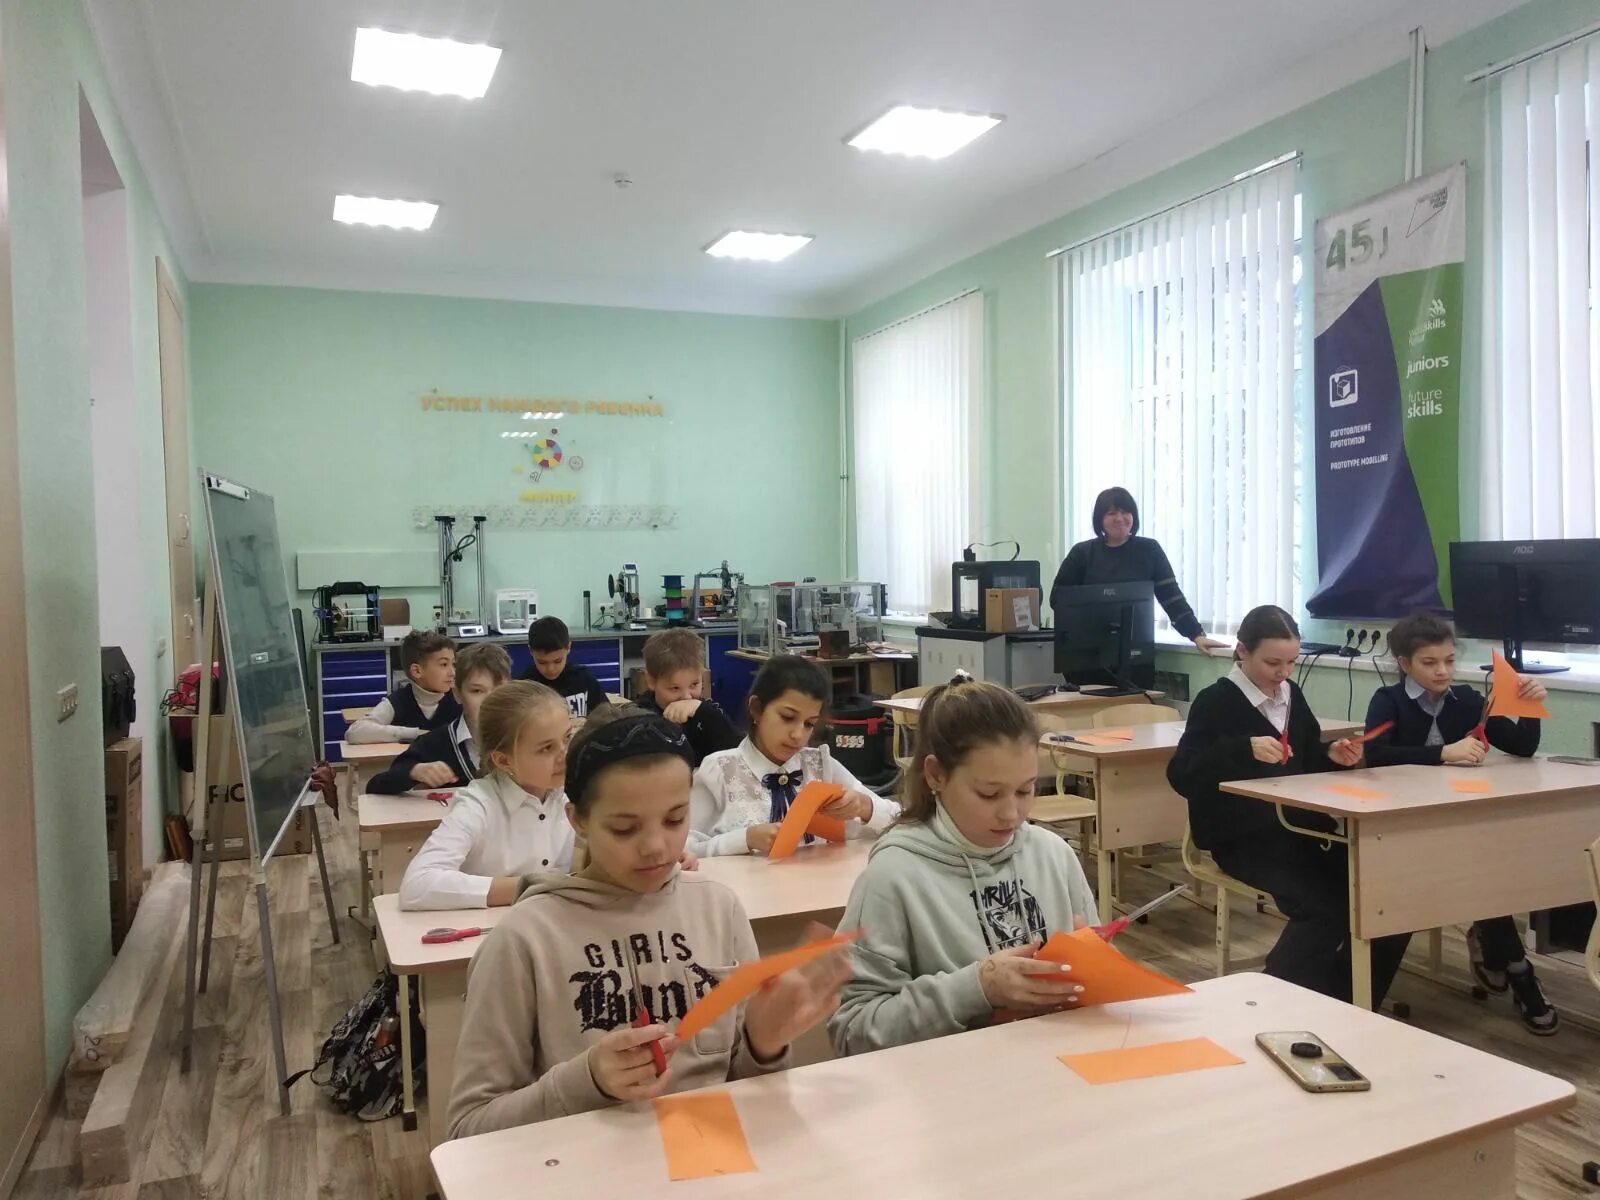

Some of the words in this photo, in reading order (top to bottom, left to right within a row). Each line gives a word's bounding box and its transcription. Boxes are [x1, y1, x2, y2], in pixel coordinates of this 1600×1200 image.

[1407, 355, 1449, 378] juniors
[422, 396, 481, 412] УСПЕХ
[1408, 389, 1442, 404] future
[1407, 400, 1442, 418] skills
[1330, 423, 1372, 438] ИЗГОТОВЛЕНИЕ
[1330, 435, 1366, 449] ПРОТОТИПОВ
[1330, 458, 1361, 470] PROTOTYPE
[1360, 454, 1389, 466] MODELLING
[1513, 545, 1534, 555] AOC
